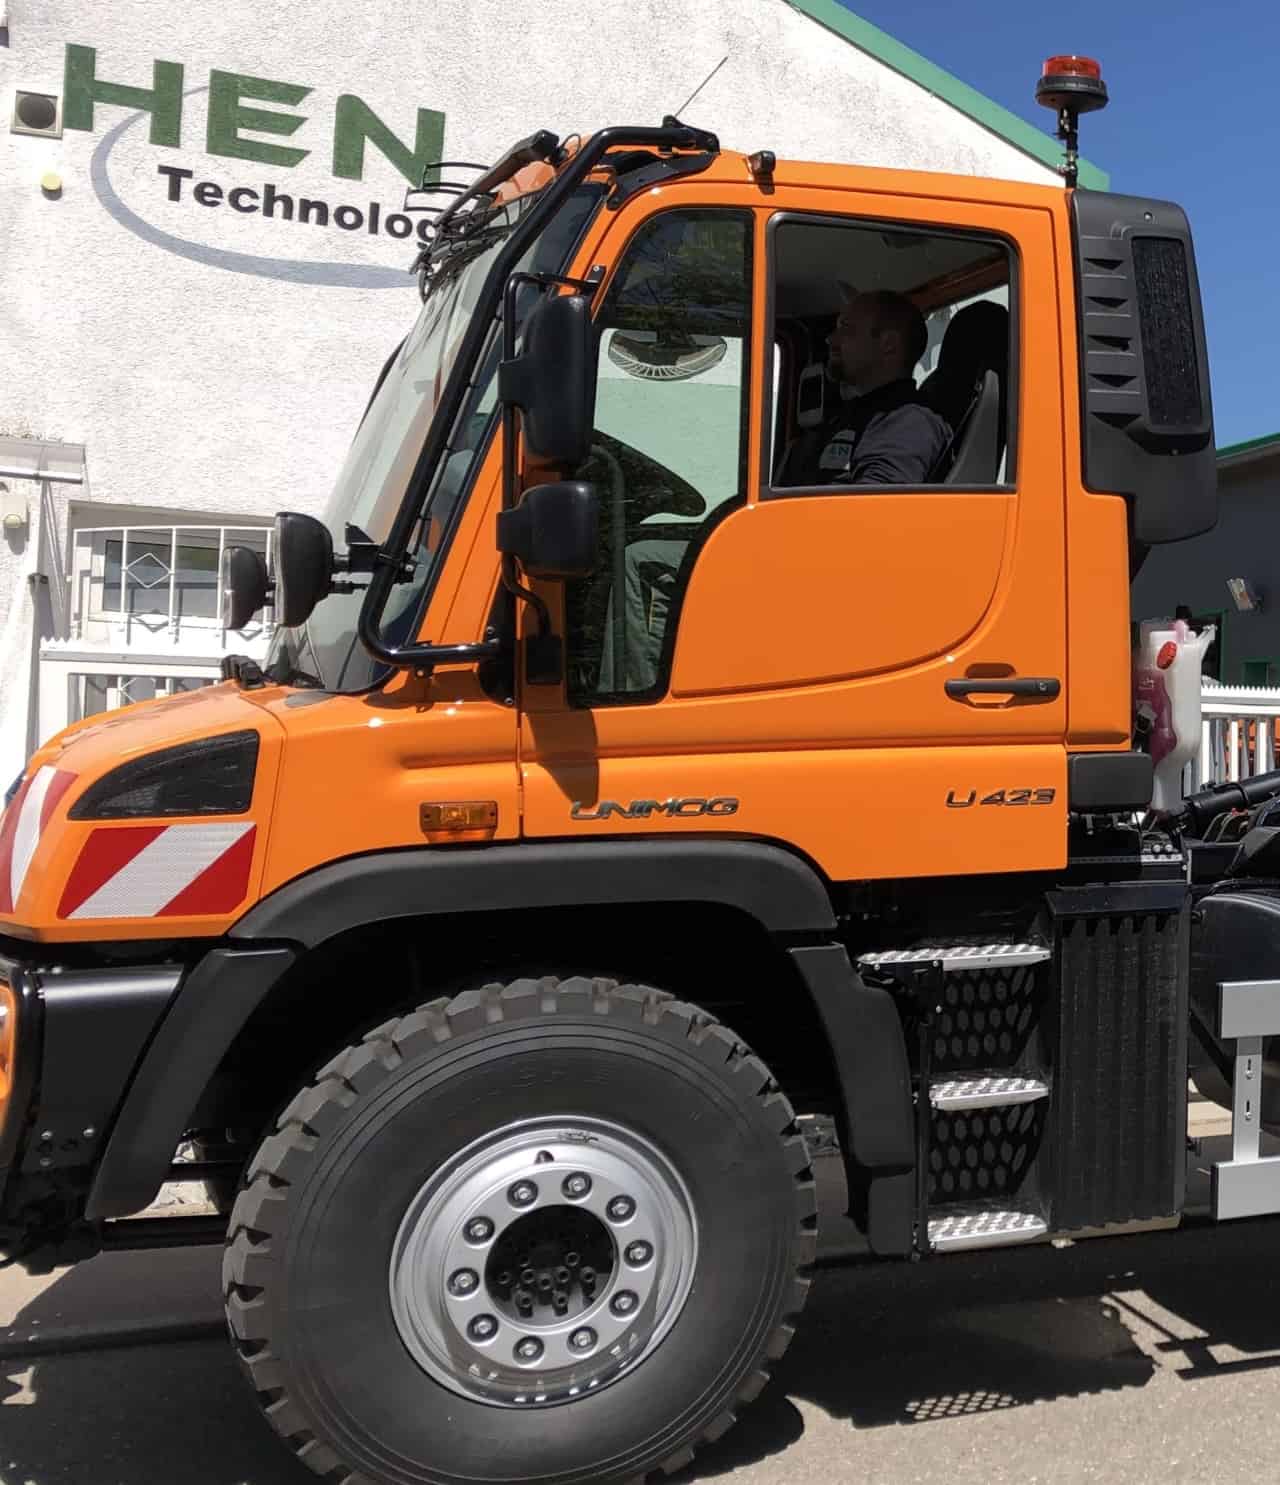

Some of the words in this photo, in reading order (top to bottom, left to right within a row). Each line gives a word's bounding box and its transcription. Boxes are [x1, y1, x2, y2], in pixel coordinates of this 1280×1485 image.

[63, 43, 446, 190] HEN
[571, 798, 739, 820] UNIMOG
[946, 789, 977, 808] U
[979, 788, 1056, 806] 423
